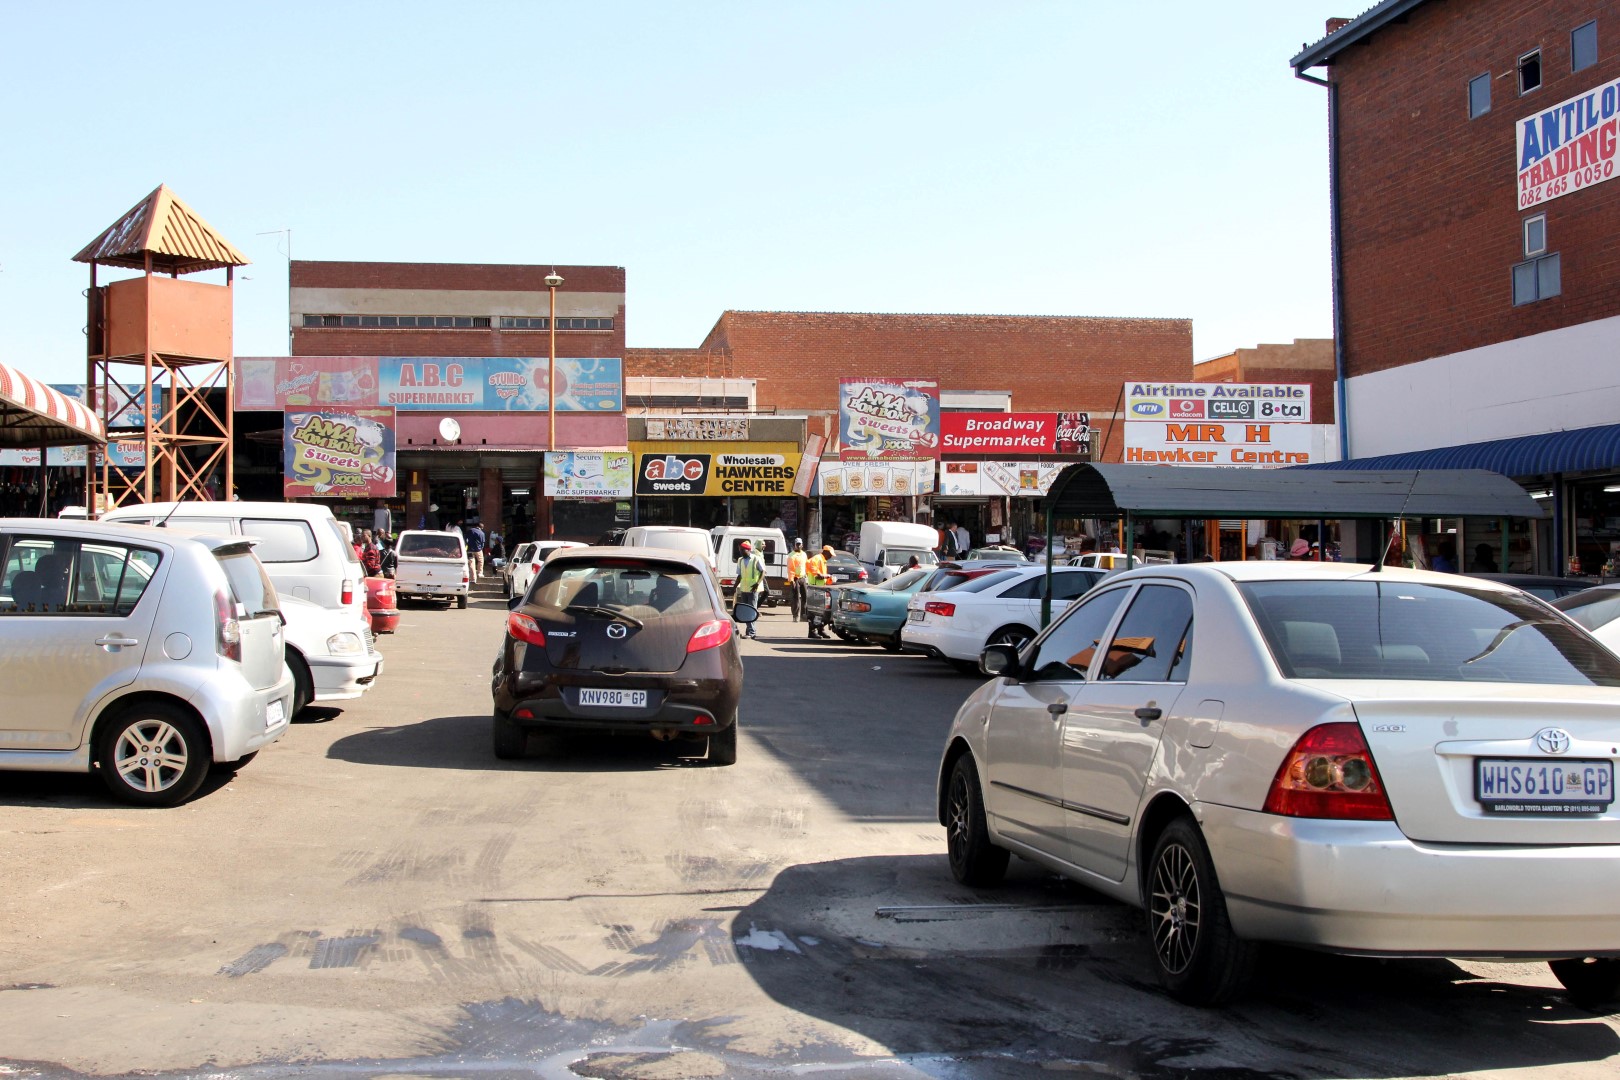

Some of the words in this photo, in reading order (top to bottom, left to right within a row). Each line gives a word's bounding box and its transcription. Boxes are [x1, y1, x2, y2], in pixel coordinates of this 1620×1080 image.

[1519, 83, 1620, 171] ANTILO
[1519, 119, 1616, 191] TRADING
[1520, 186, 1542, 207] 082
[1546, 176, 1567, 198] 665
[1574, 160, 1613, 187] 0050
[400, 364, 463, 387] A.B.C
[489, 373, 526, 386] STUMBO
[388, 392, 474, 403] SUPERMARKET
[861, 388, 905, 410] AMA
[1131, 384, 1206, 397] Airtime
[1212, 385, 1304, 398] Available
[849, 398, 875, 416] BOM
[879, 408, 909, 421] BOM
[1137, 404, 1158, 412] MTN
[306, 416, 357, 443] AMA
[858, 416, 908, 435] Sweets
[966, 418, 1044, 432] Broadway
[1056, 424, 1090, 441] Coca-Cola
[1166, 424, 1225, 442] MR
[1245, 425, 1270, 442] H
[117, 443, 146, 452] STUMB
[294, 427, 323, 446] BOM
[328, 438, 361, 454] BOM
[943, 435, 1046, 448] Supermarket
[304, 448, 360, 468] Sweets
[607, 457, 628, 469] MAQ
[723, 455, 775, 465] Wholesale
[1126, 447, 1218, 463] Hawker
[1231, 448, 1309, 464] Centre
[645, 455, 703, 480] abc
[716, 467, 794, 479] HAWKERS
[653, 482, 691, 491] sweets
[722, 480, 784, 492] CENTRE
[581, 690, 622, 704] XNV980
[632, 691, 645, 705] GP
[1482, 766, 1563, 795] WHS610
[1584, 767, 1609, 796] GP
